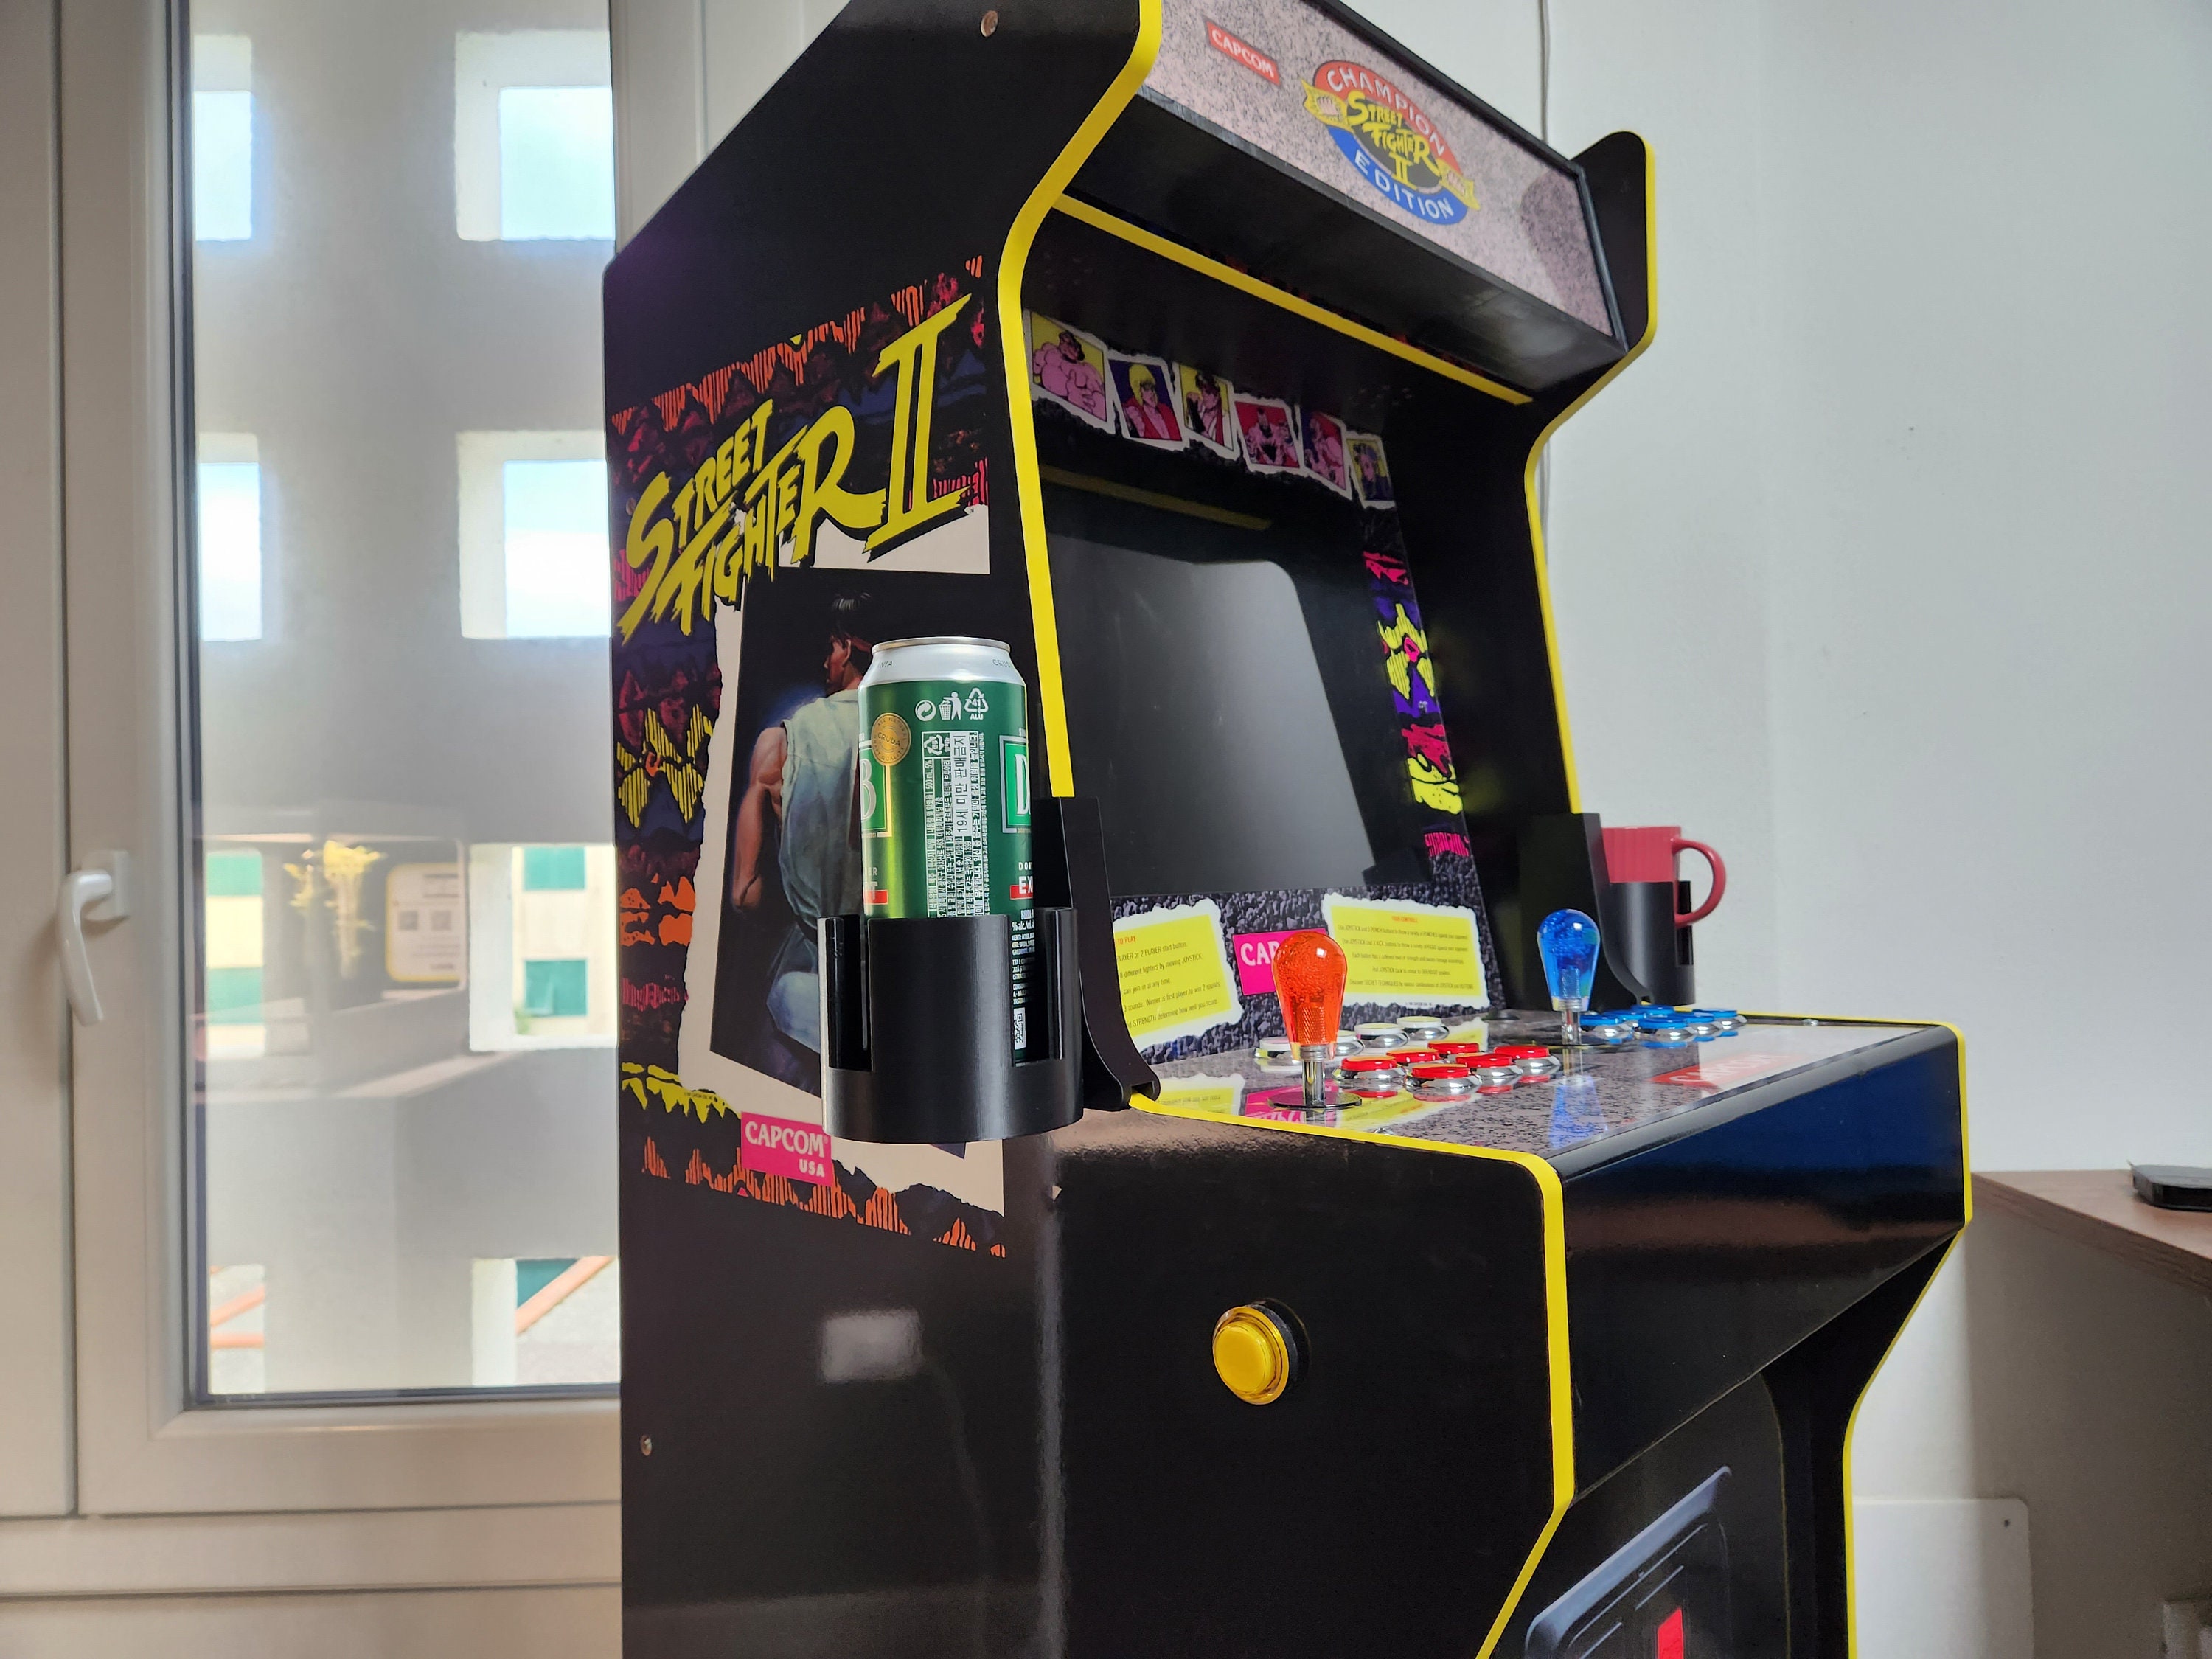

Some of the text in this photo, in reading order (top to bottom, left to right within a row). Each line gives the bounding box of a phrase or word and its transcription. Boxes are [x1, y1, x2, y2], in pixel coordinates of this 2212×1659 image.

[1211, 29, 1275, 78] CAPCOM
[1327, 67, 1445, 156] CHAMPION
[1346, 91, 1402, 128] STREET
[1361, 122, 1440, 177] FIGHTER
[1355, 150, 1454, 219] EDITION
[1388, 152, 1417, 189] II
[650, 293, 972, 636] FIGHTER II
[617, 399, 774, 645] STREET
[877, 731, 901, 747] CRUDA
[953, 735, 967, 779] 판매금지
[954, 783, 967, 804] 미만
[956, 809, 969, 832] 19세
[1145, 947, 1162, 956] PLAYER
[1133, 1014, 1157, 1026] STRENGTH
[1146, 998, 1161, 1006] Winner
[745, 1121, 825, 1158] CAPCOM
[799, 1158, 825, 1178] USA
